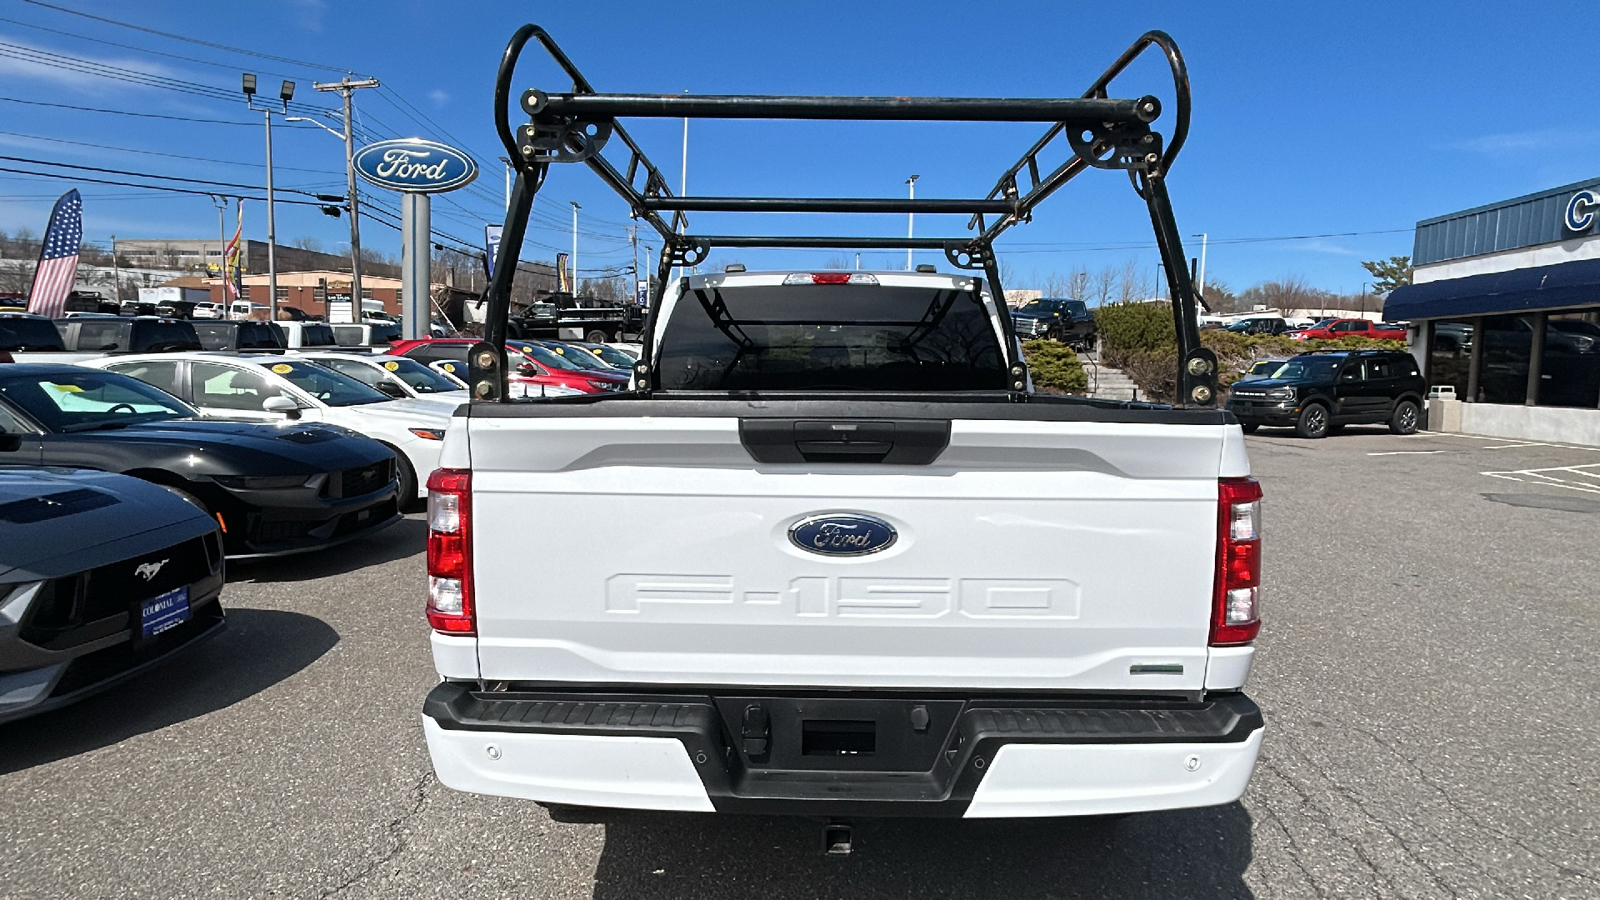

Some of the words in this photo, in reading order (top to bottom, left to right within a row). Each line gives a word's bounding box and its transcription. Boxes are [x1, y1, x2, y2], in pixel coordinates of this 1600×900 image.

[376, 149, 448, 180] Ford
[813, 522, 872, 548] Ford
[605, 573, 1080, 619] F-150
